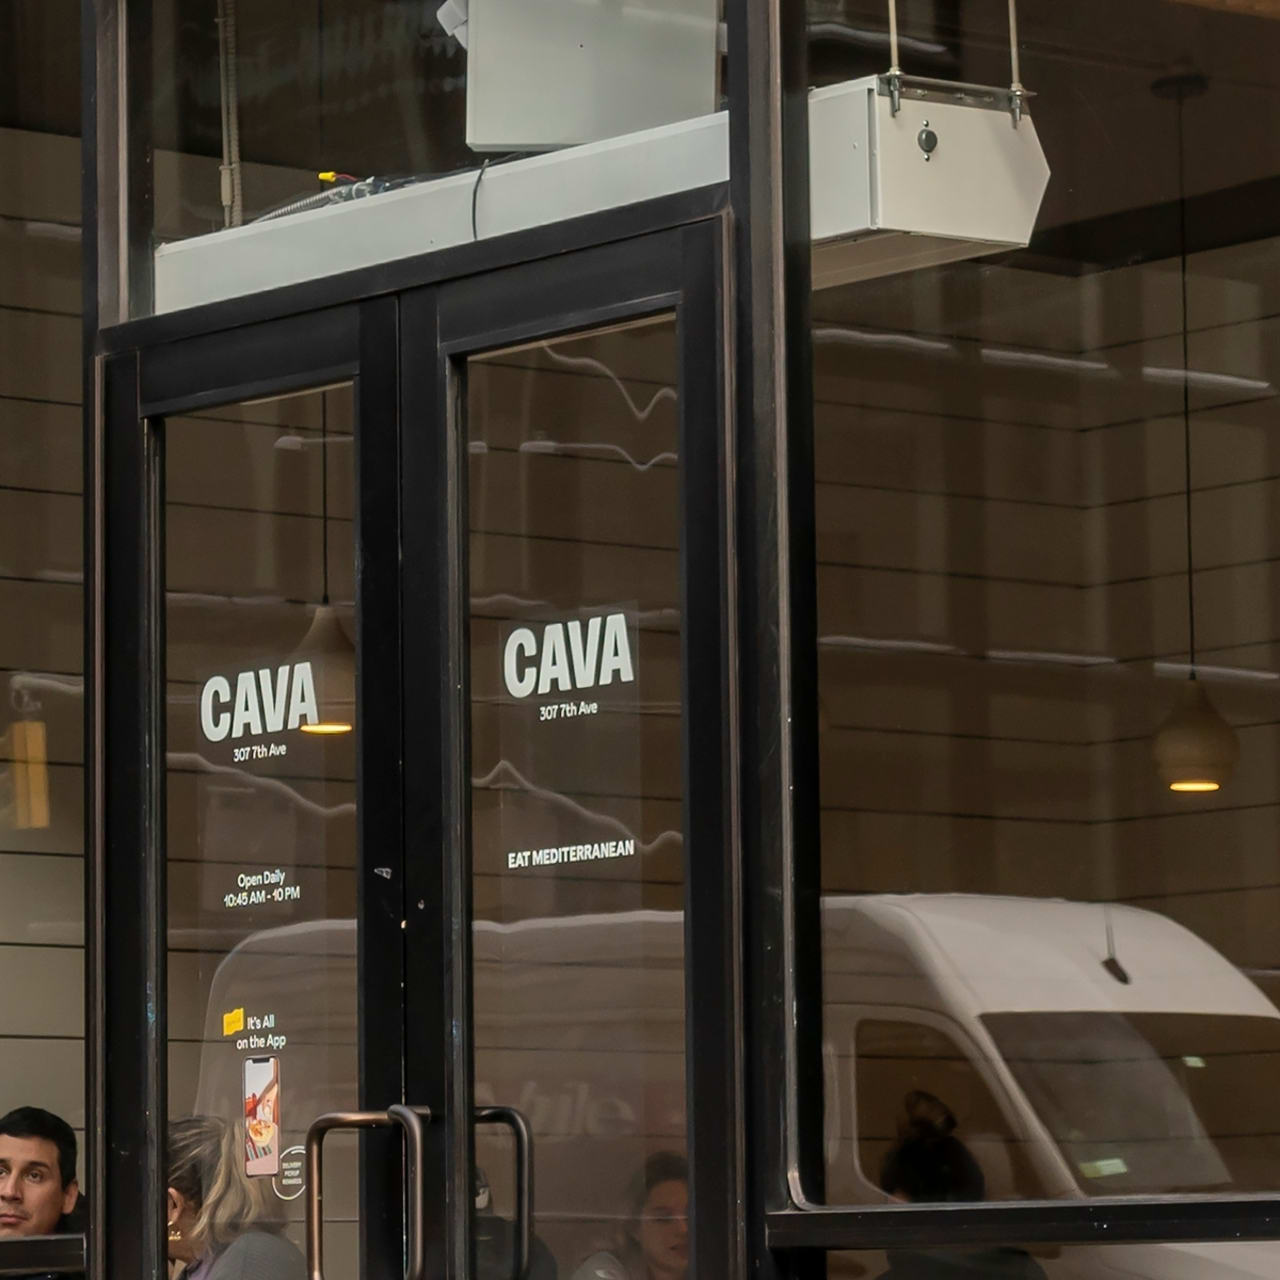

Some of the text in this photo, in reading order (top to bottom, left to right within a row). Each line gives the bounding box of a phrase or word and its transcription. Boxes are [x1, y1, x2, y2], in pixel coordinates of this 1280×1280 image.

[504, 613, 634, 699] CAVA
[201, 662, 319, 742] CAVA
[540, 701, 598, 721] 307 7th Ave
[233, 743, 287, 762] 307 7th Ave
[508, 839, 635, 869] EAT MEDITERRANEAN
[237, 868, 286, 890] Open Daily
[224, 891, 248, 907] 10:45
[249, 890, 266, 904] AM
[272, 887, 284, 901] 10
[285, 885, 300, 900] PM
[247, 1014, 275, 1029] It's All
[236, 1033, 287, 1050] on the App
